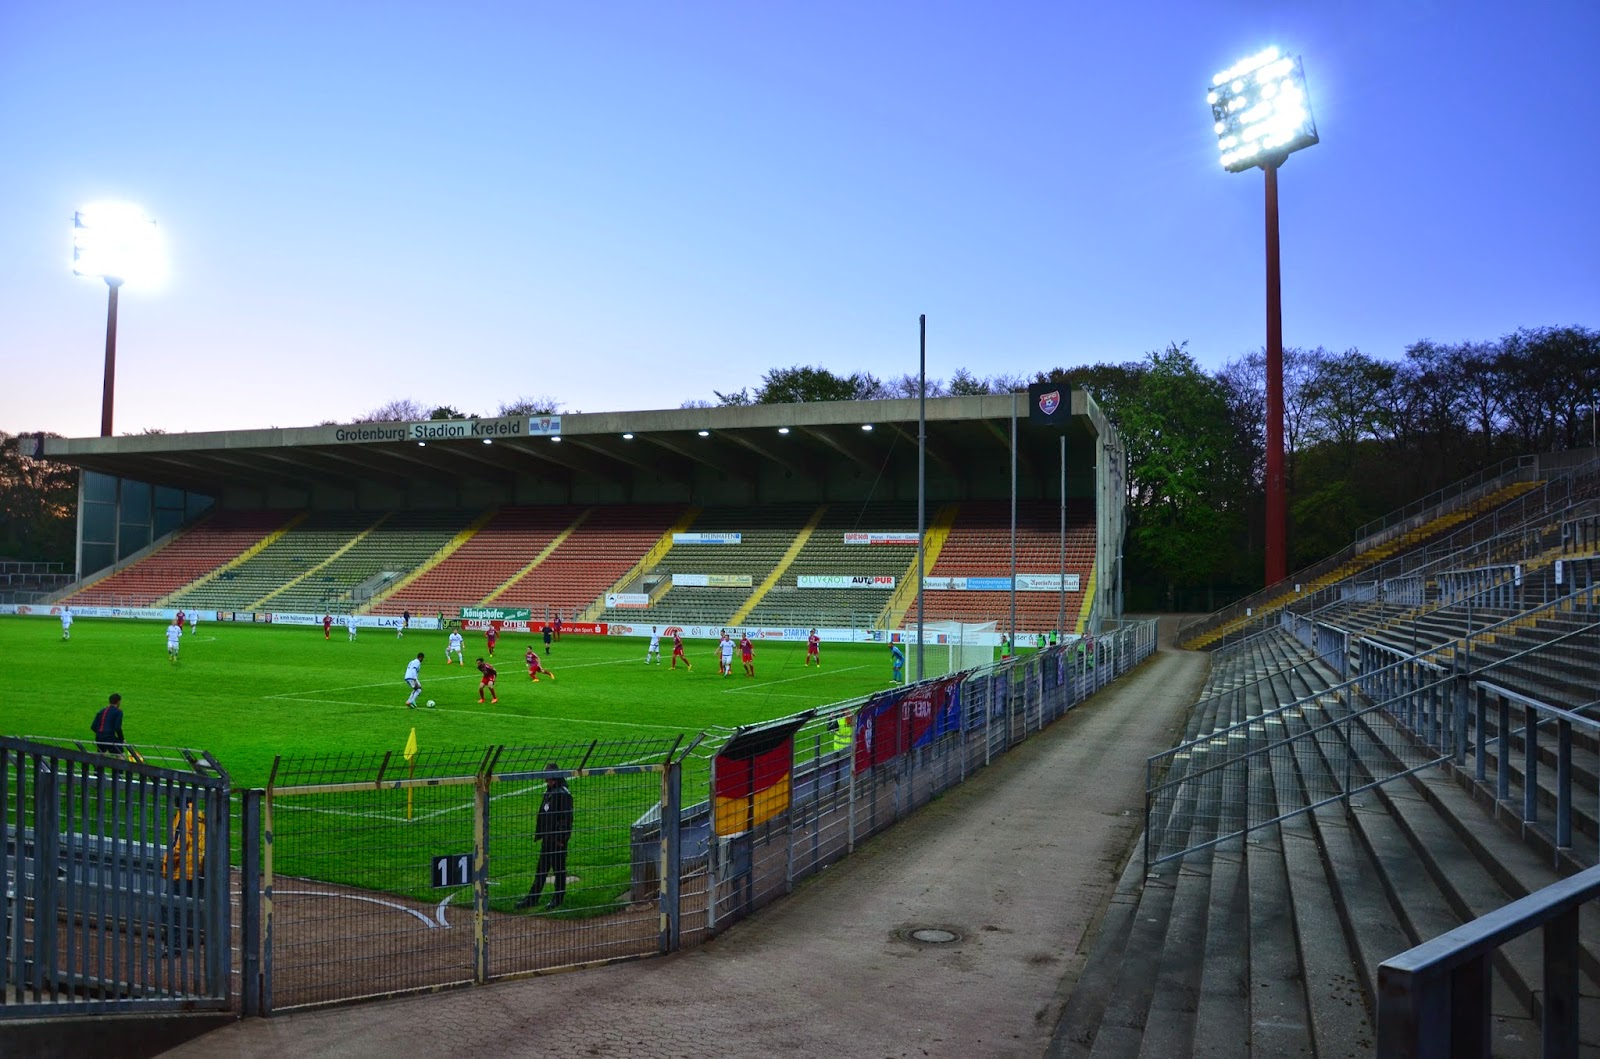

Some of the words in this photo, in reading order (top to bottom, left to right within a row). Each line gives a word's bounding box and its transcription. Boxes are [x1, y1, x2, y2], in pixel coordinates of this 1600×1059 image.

[335, 427, 405, 441] Grotenburg
[470, 420, 520, 436] Krefeld
[462, 607, 505, 619] Königshofer
[503, 620, 527, 628] OTTEN
[437, 855, 468, 886] 11
